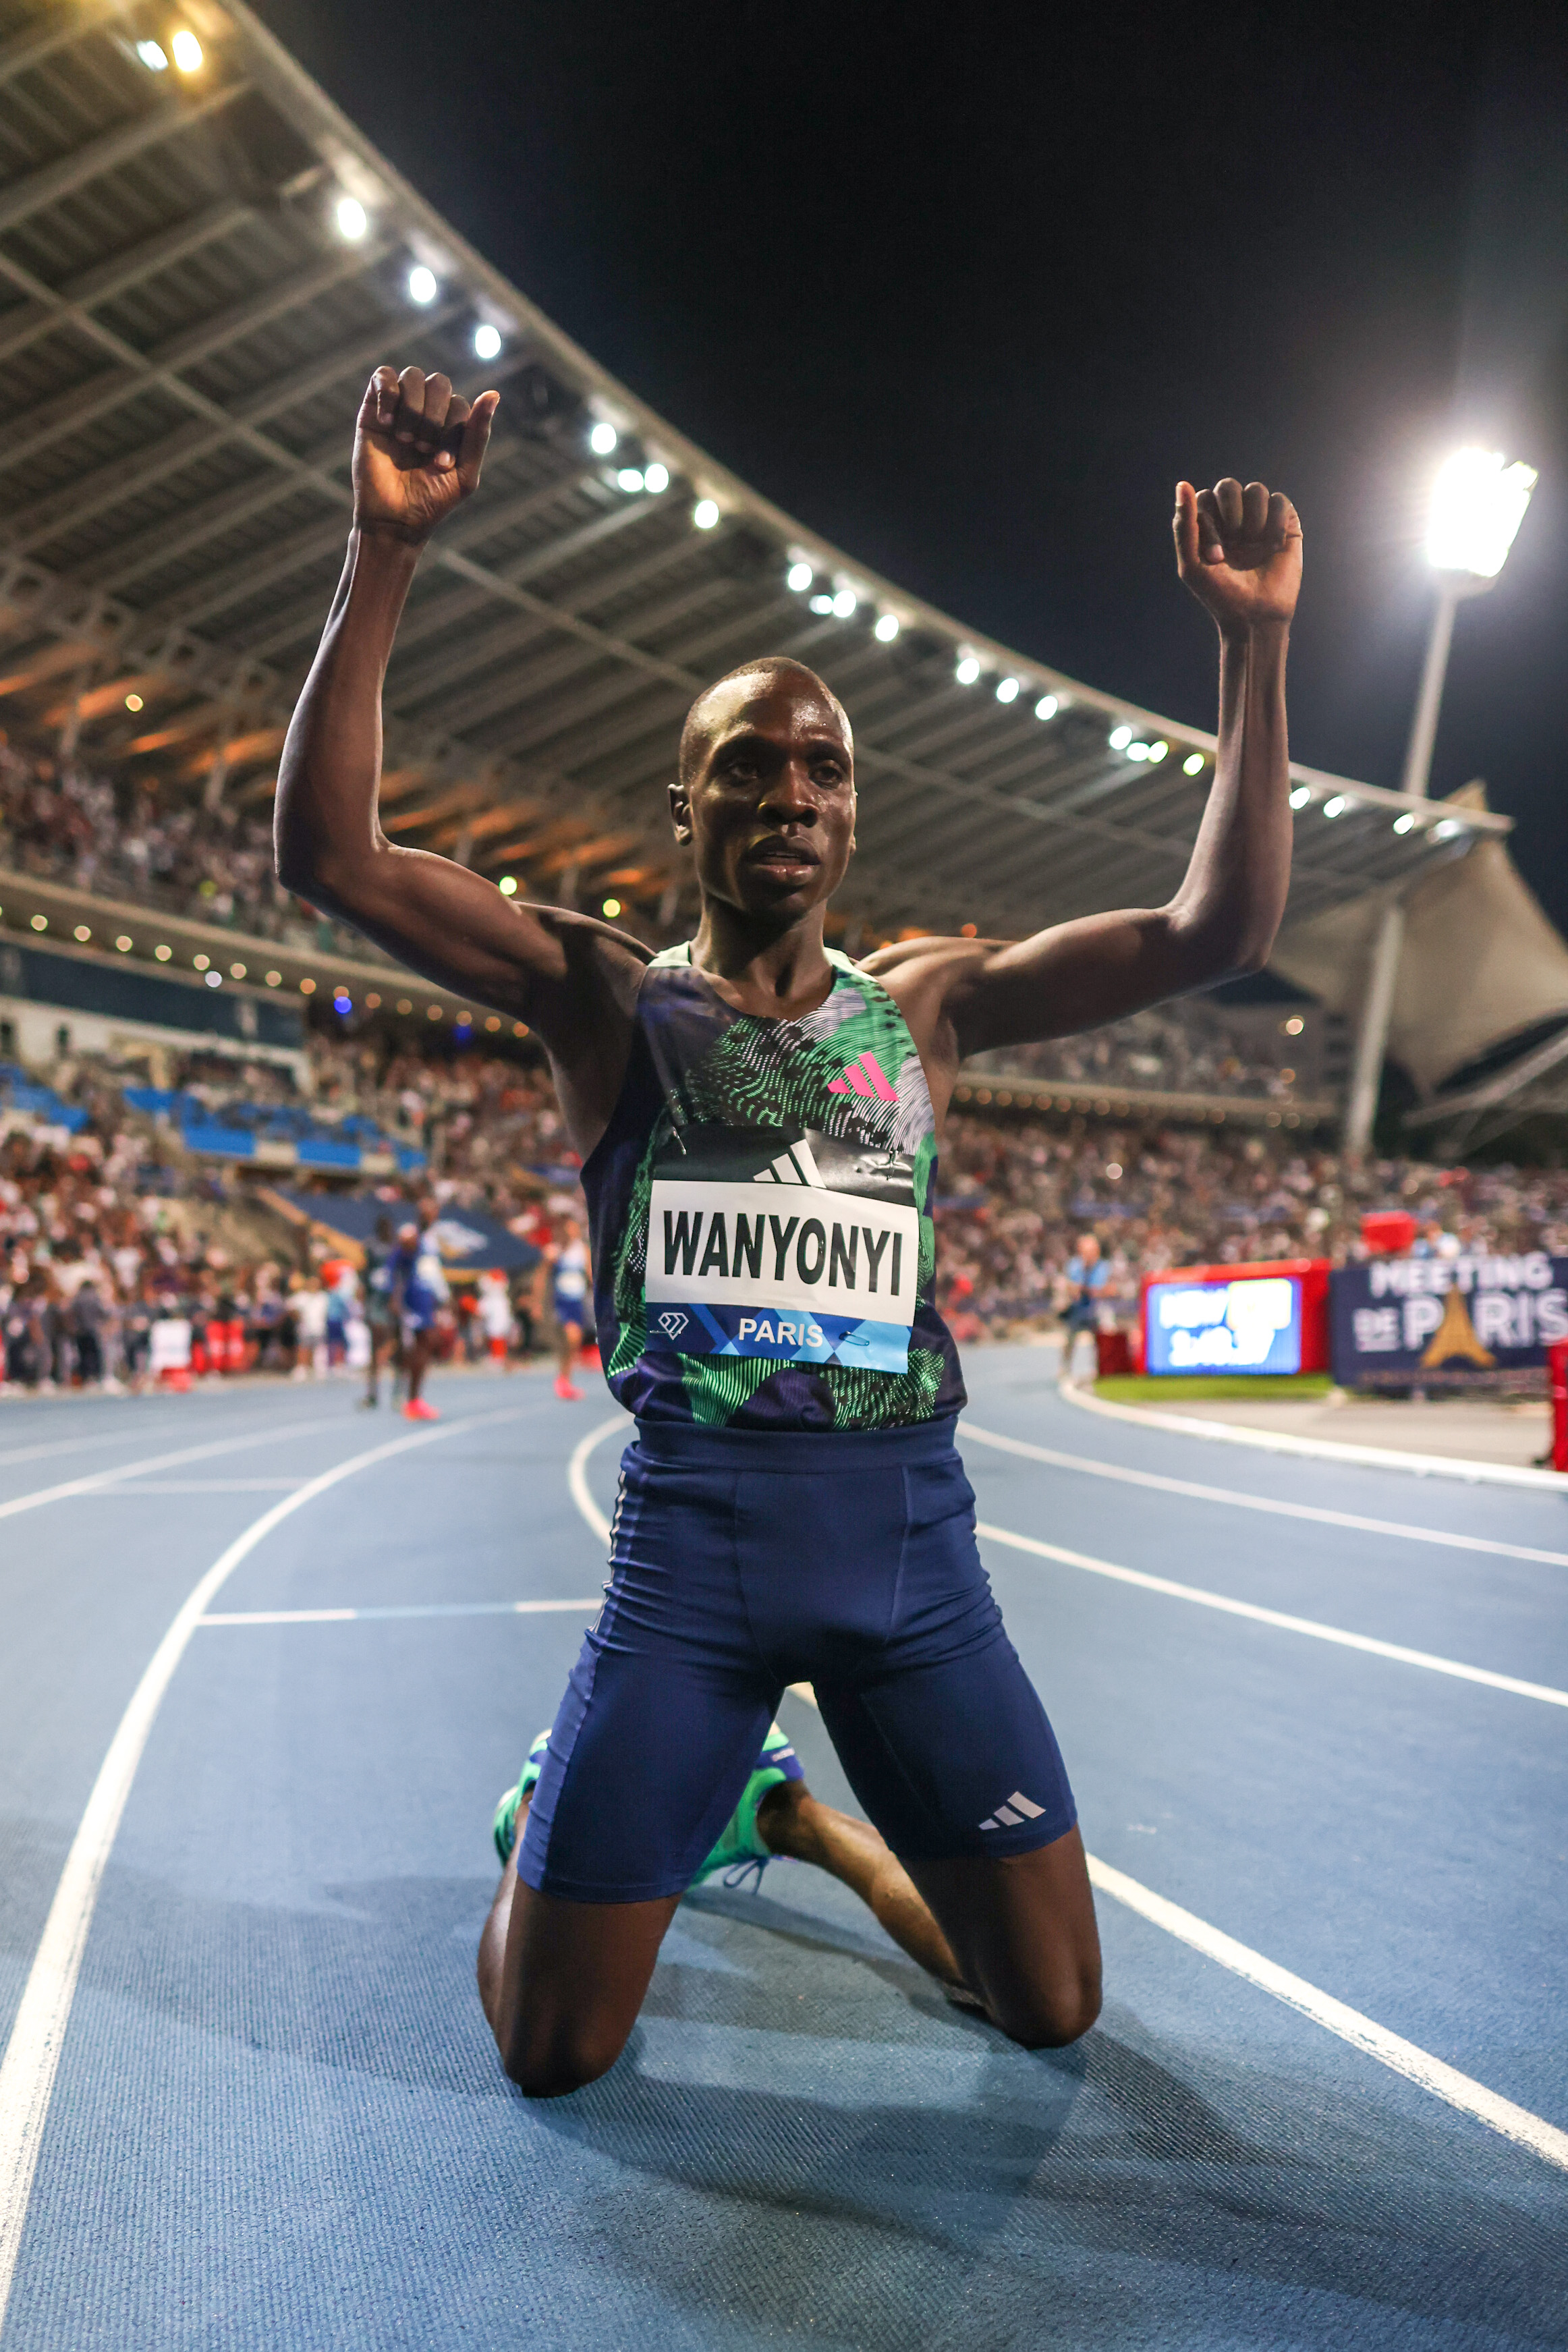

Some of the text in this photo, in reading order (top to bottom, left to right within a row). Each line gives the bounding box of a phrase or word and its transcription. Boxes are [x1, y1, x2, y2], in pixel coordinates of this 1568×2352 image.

[663, 1210, 903, 1296] WANYONYI
[1370, 1253, 1553, 1297] MEETING
[738, 1318, 823, 1348] PARIS
